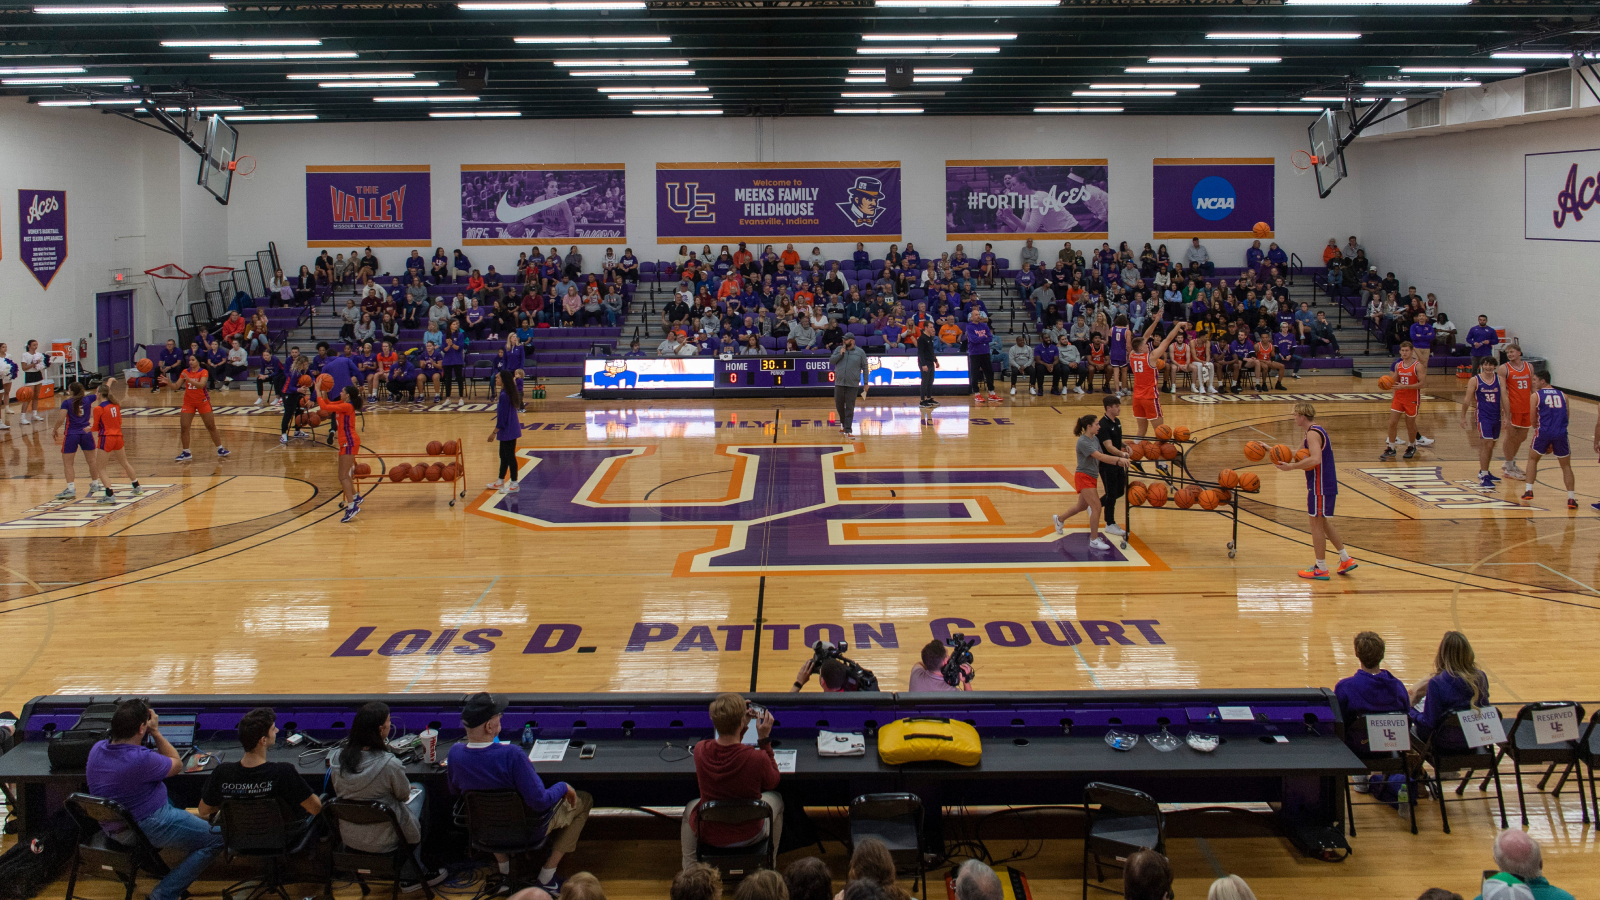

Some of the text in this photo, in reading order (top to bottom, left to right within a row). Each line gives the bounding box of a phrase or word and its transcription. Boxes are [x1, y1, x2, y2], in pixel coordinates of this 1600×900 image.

[355, 185, 379, 195] THE
[735, 187, 820, 202] MEEKS FAMILY
[330, 184, 407, 222] VALLEY
[665, 182, 716, 224] UE
[1196, 197, 1235, 210] NCAA
[744, 202, 815, 217] FIELDHOUSE
[739, 218, 784, 226] Evansville,
[725, 362, 748, 371] HOME
[806, 362, 830, 370] GUEST
[1134, 360, 1144, 372] 13
[730, 372, 737, 383] 0
[777, 376, 782, 384] 1
[828, 372, 835, 382] 0
[1401, 376, 1409, 385] 23
[1517, 380, 1528, 390] 33
[1484, 394, 1496, 402] 32
[1544, 395, 1562, 408] 40
[110, 407, 118, 418] 13
[1357, 466, 1550, 511] VALLEY
[329, 617, 1170, 658] LOIS D. PATTON COURT
[1537, 711, 1573, 722] RESERVED
[1476, 722, 1491, 734] UE
[1550, 722, 1564, 732] UE
[1383, 728, 1396, 740] UE
[222, 780, 273, 790] GODSMACK
